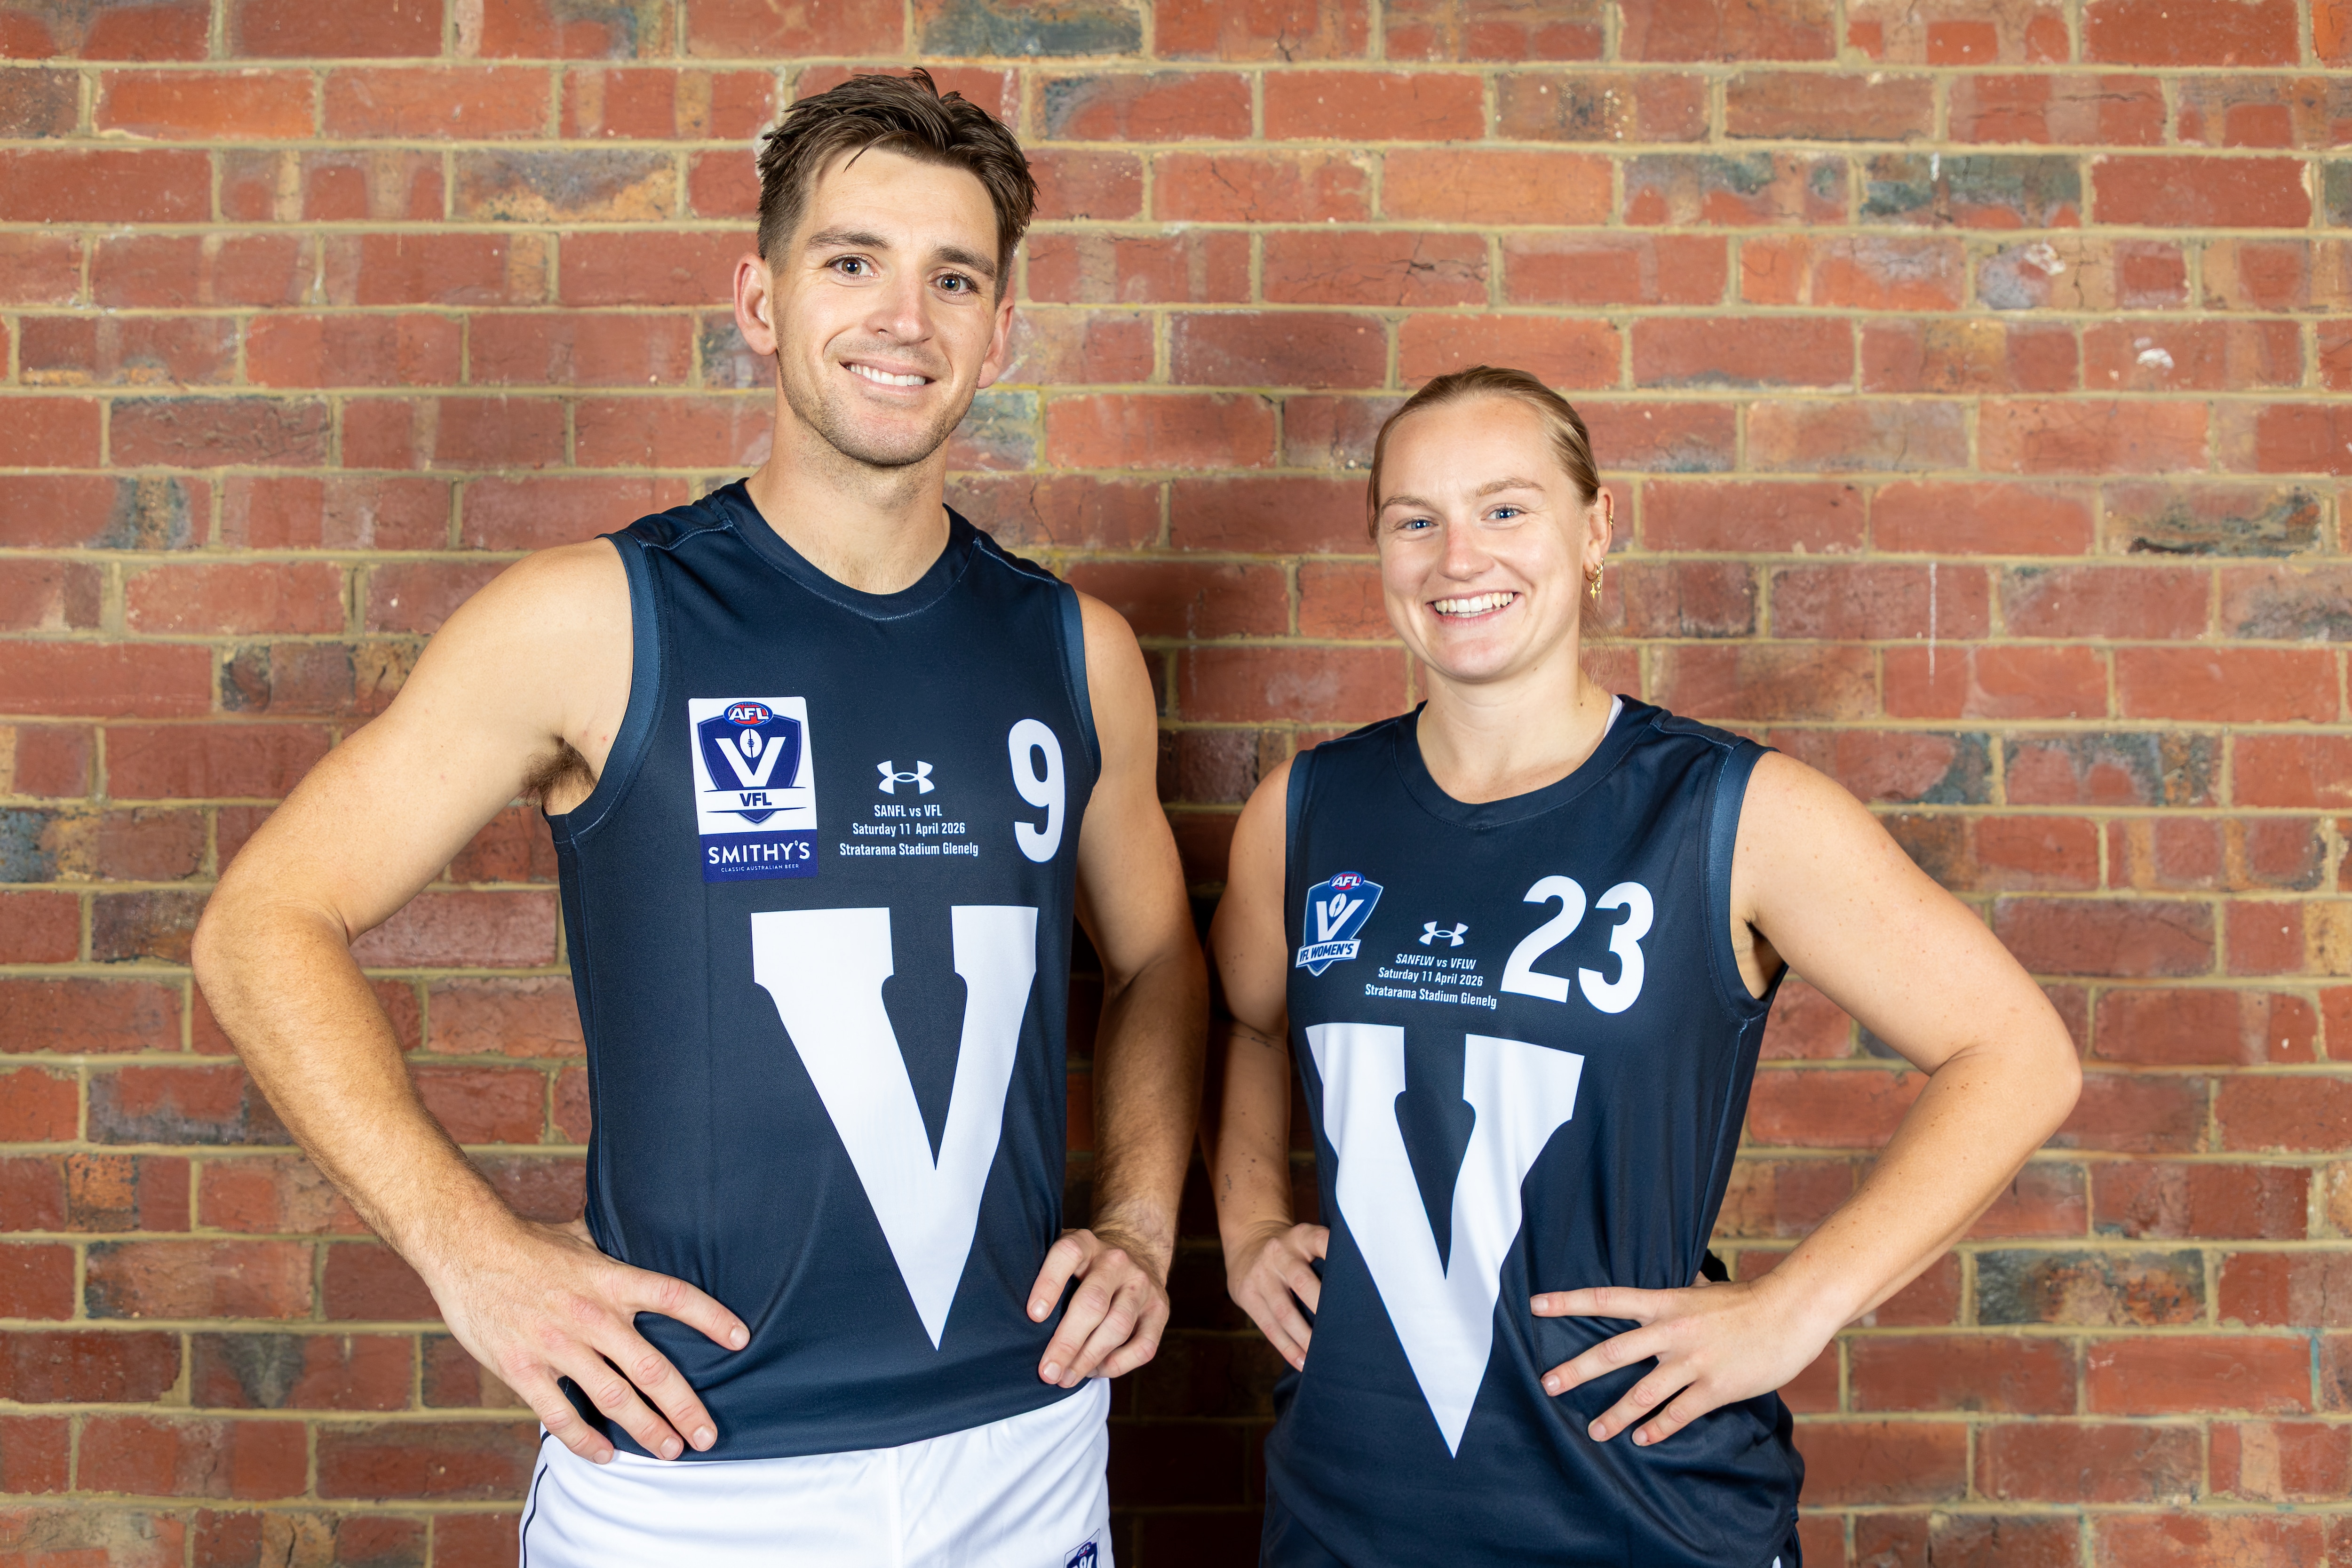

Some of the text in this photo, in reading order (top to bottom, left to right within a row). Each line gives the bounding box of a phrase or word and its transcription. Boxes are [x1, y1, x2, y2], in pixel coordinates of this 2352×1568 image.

[729, 708, 769, 720] AFL
[715, 737, 786, 788] V
[739, 793, 772, 806] VFL
[1008, 719, 1065, 863] 9
[874, 804, 942, 817] SANFL vs VFL
[852, 822, 965, 837] Saturday 11 April 2026
[708, 840, 810, 864] SMITHY'S
[840, 842, 978, 857] Stratarama Stadium Glenelg
[1331, 876, 1360, 887] AFL
[1316, 899, 1364, 942] V
[1300, 943, 1354, 962] VFL WOMEN'S
[1501, 875, 1654, 1014] 23
[1396, 954, 1435, 966] SANFLW
[1450, 958, 1477, 970] VFLW
[1378, 967, 1483, 987] Saturday 11 April 2026
[1365, 984, 1497, 1010] Stratarama Stadium Glenelg
[751, 905, 1038, 1351] V
[1306, 1022, 1585, 1459] V
[1078, 1544, 1090, 1556] AFL
